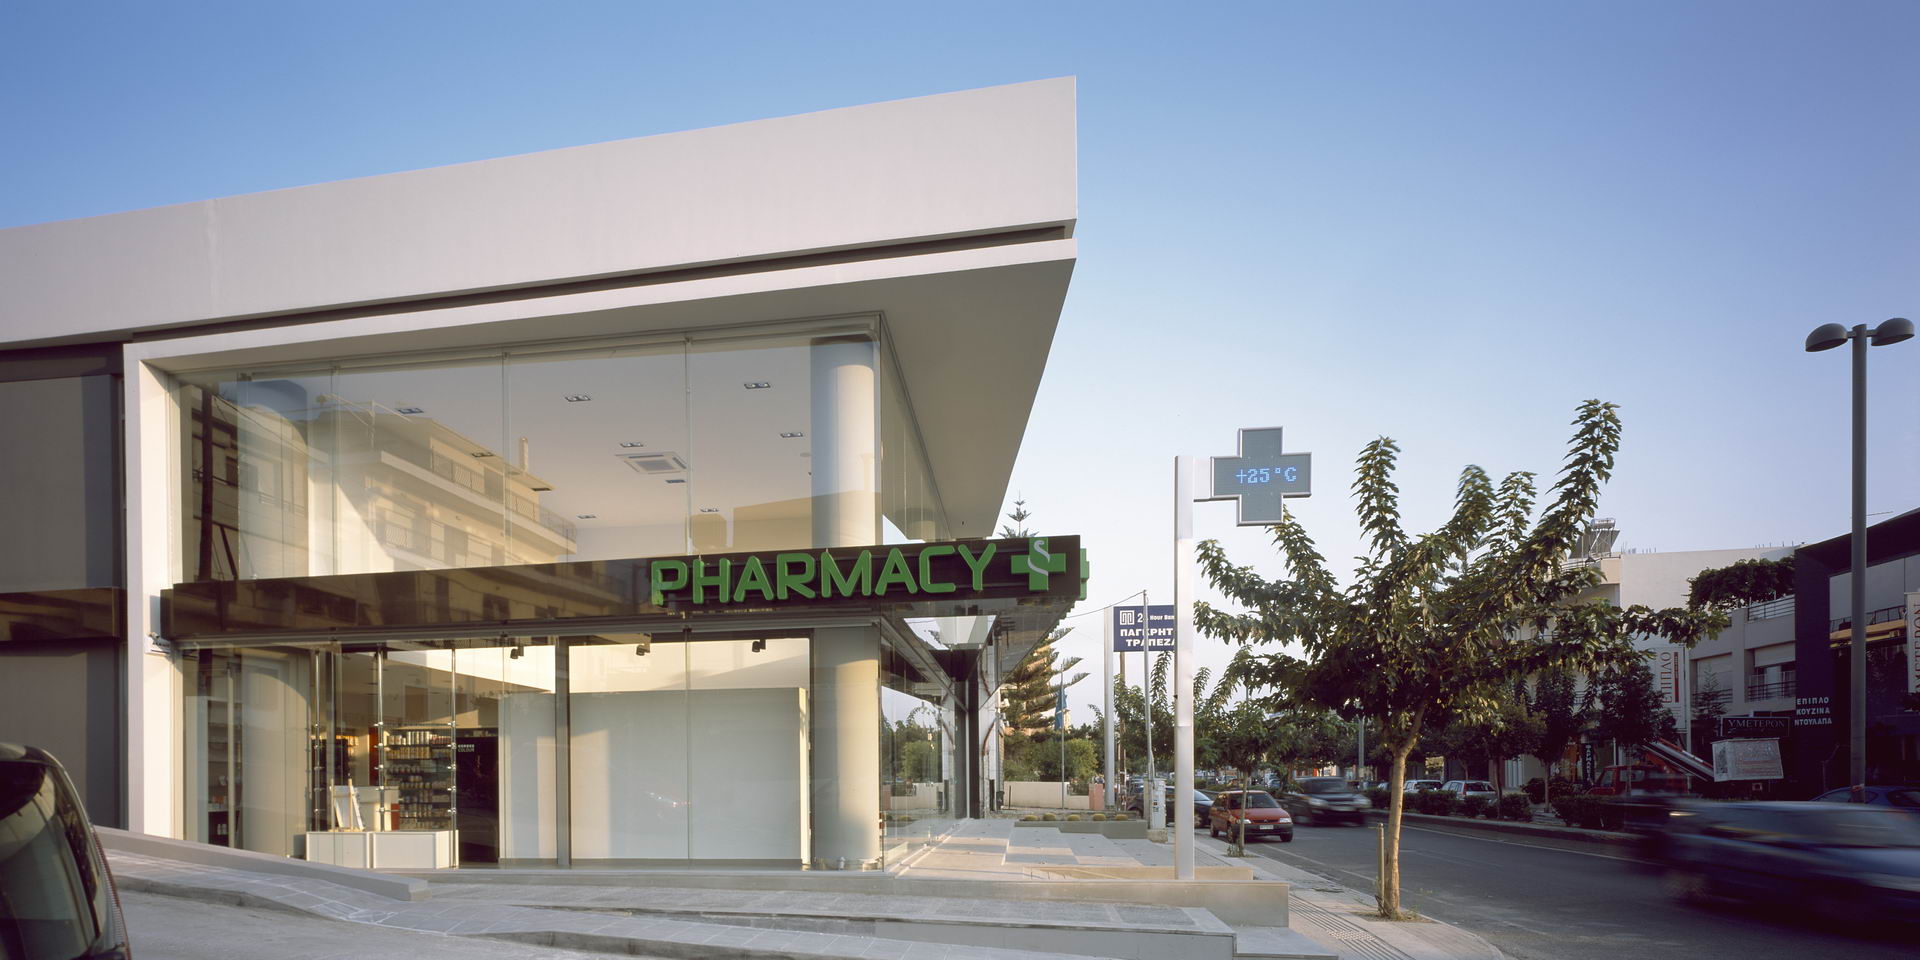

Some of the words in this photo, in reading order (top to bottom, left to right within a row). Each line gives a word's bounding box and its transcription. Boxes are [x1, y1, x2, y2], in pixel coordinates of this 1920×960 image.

[651, 543, 997, 606] PHARMACY
[1796, 696, 1829, 705] ΕΠΙΠΛΟ
[1796, 707, 1830, 715] ΚΟΥΖΙΝΑ
[1728, 719, 1785, 728] ΥΜΕΤΕΡΟΝ
[1794, 718, 1832, 726] ΝΤΟΥΛΑΠΑ
